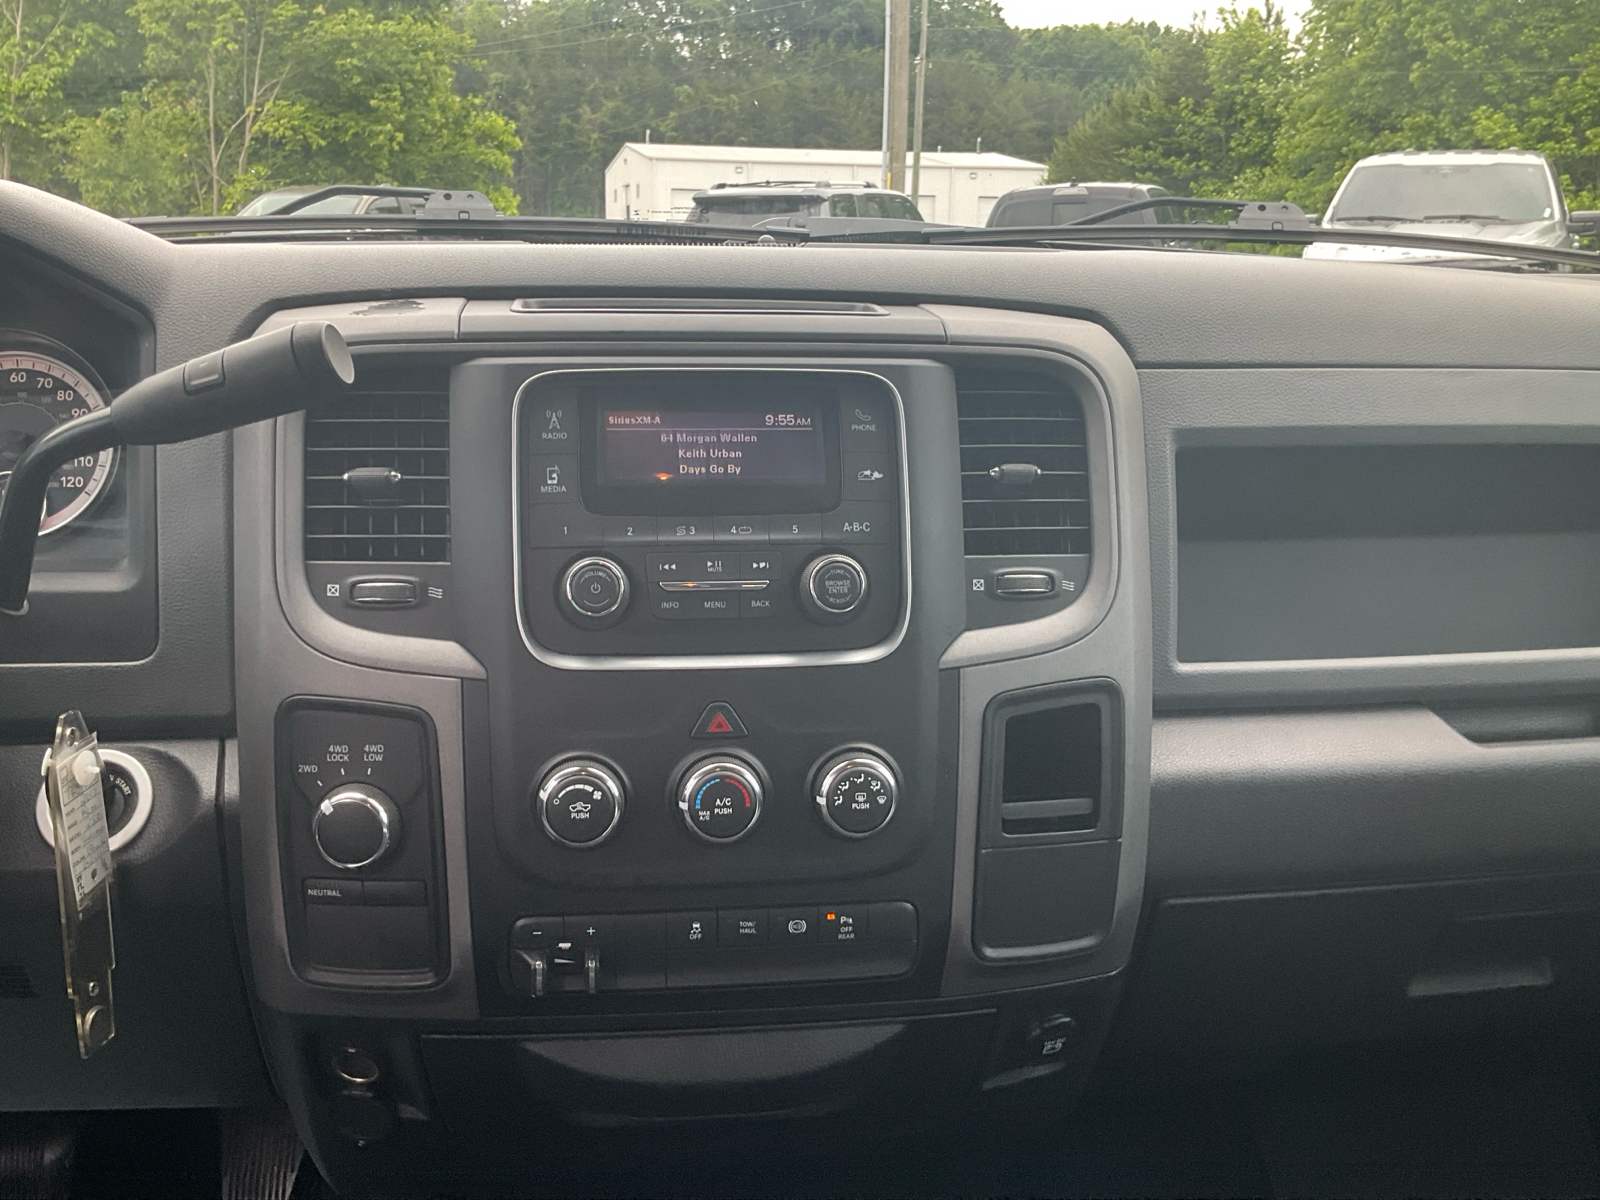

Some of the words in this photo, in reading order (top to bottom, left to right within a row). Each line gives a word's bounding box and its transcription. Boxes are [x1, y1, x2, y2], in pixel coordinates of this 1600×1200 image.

[9, 372, 26, 382] 60
[36, 378, 53, 388] 70
[56, 390, 74, 401] 80
[608, 416, 661, 425] SiriusXM-A
[660, 434, 673, 443] 64
[676, 434, 717, 444] Morgan
[720, 433, 758, 442] Wallen
[678, 449, 706, 458] Keith
[710, 449, 742, 458] Urban
[680, 464, 706, 474] Days
[710, 464, 724, 474] Go
[728, 464, 742, 475] By
[60, 476, 84, 488] 120
[563, 526, 568, 535] 1
[627, 527, 633, 536] 2
[689, 526, 696, 535] 3
[730, 526, 737, 534] 4
[792, 525, 798, 534] 5
[328, 744, 348, 753] 4WD
[364, 744, 384, 752] 4WD
[326, 754, 349, 762] LOCK
[298, 764, 318, 773] 2WD
[115, 777, 132, 796] START
[715, 797, 732, 806] A/C
[308, 888, 342, 897] NEUTRAL
